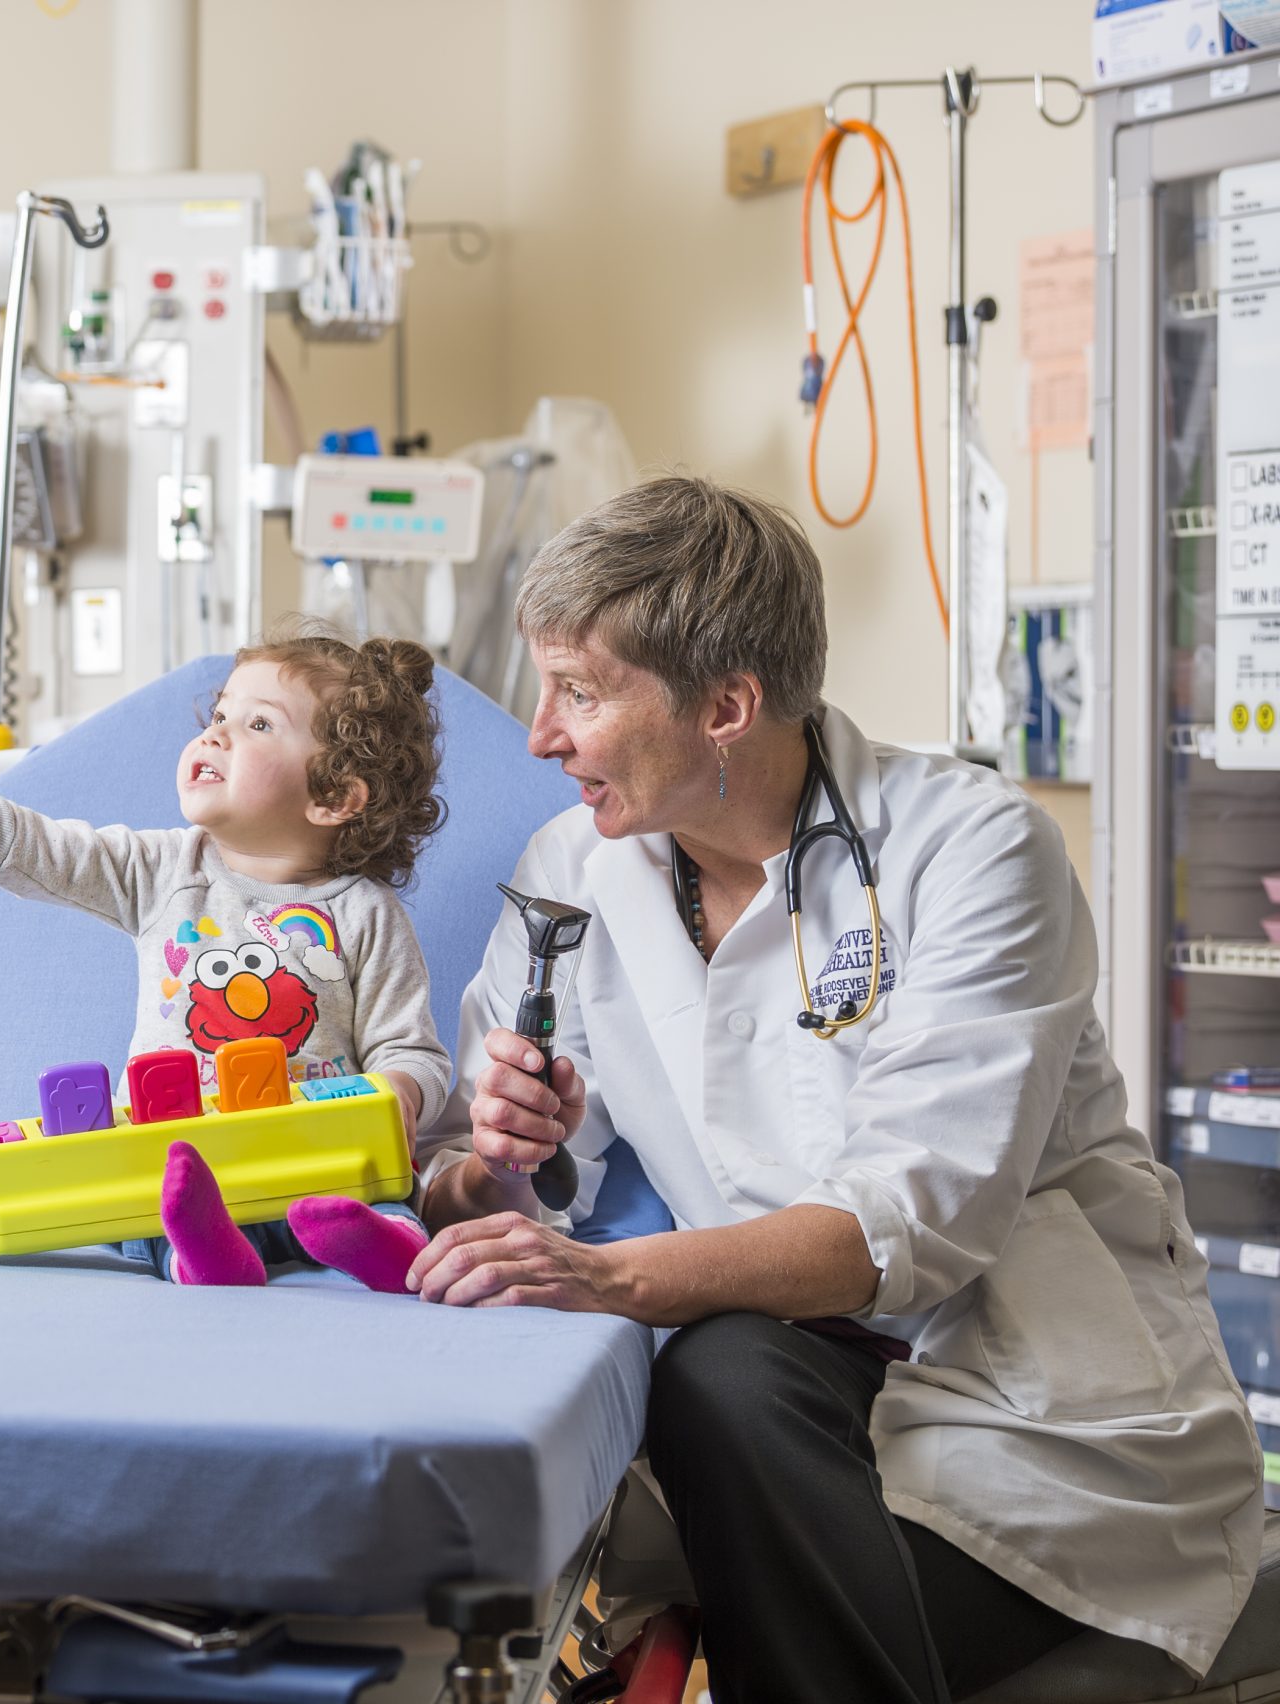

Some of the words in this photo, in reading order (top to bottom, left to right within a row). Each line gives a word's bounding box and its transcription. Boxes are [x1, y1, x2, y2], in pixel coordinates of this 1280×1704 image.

[1249, 542, 1267, 567] CT
[252, 916, 279, 947] Elmo
[880, 969, 895, 982] MD
